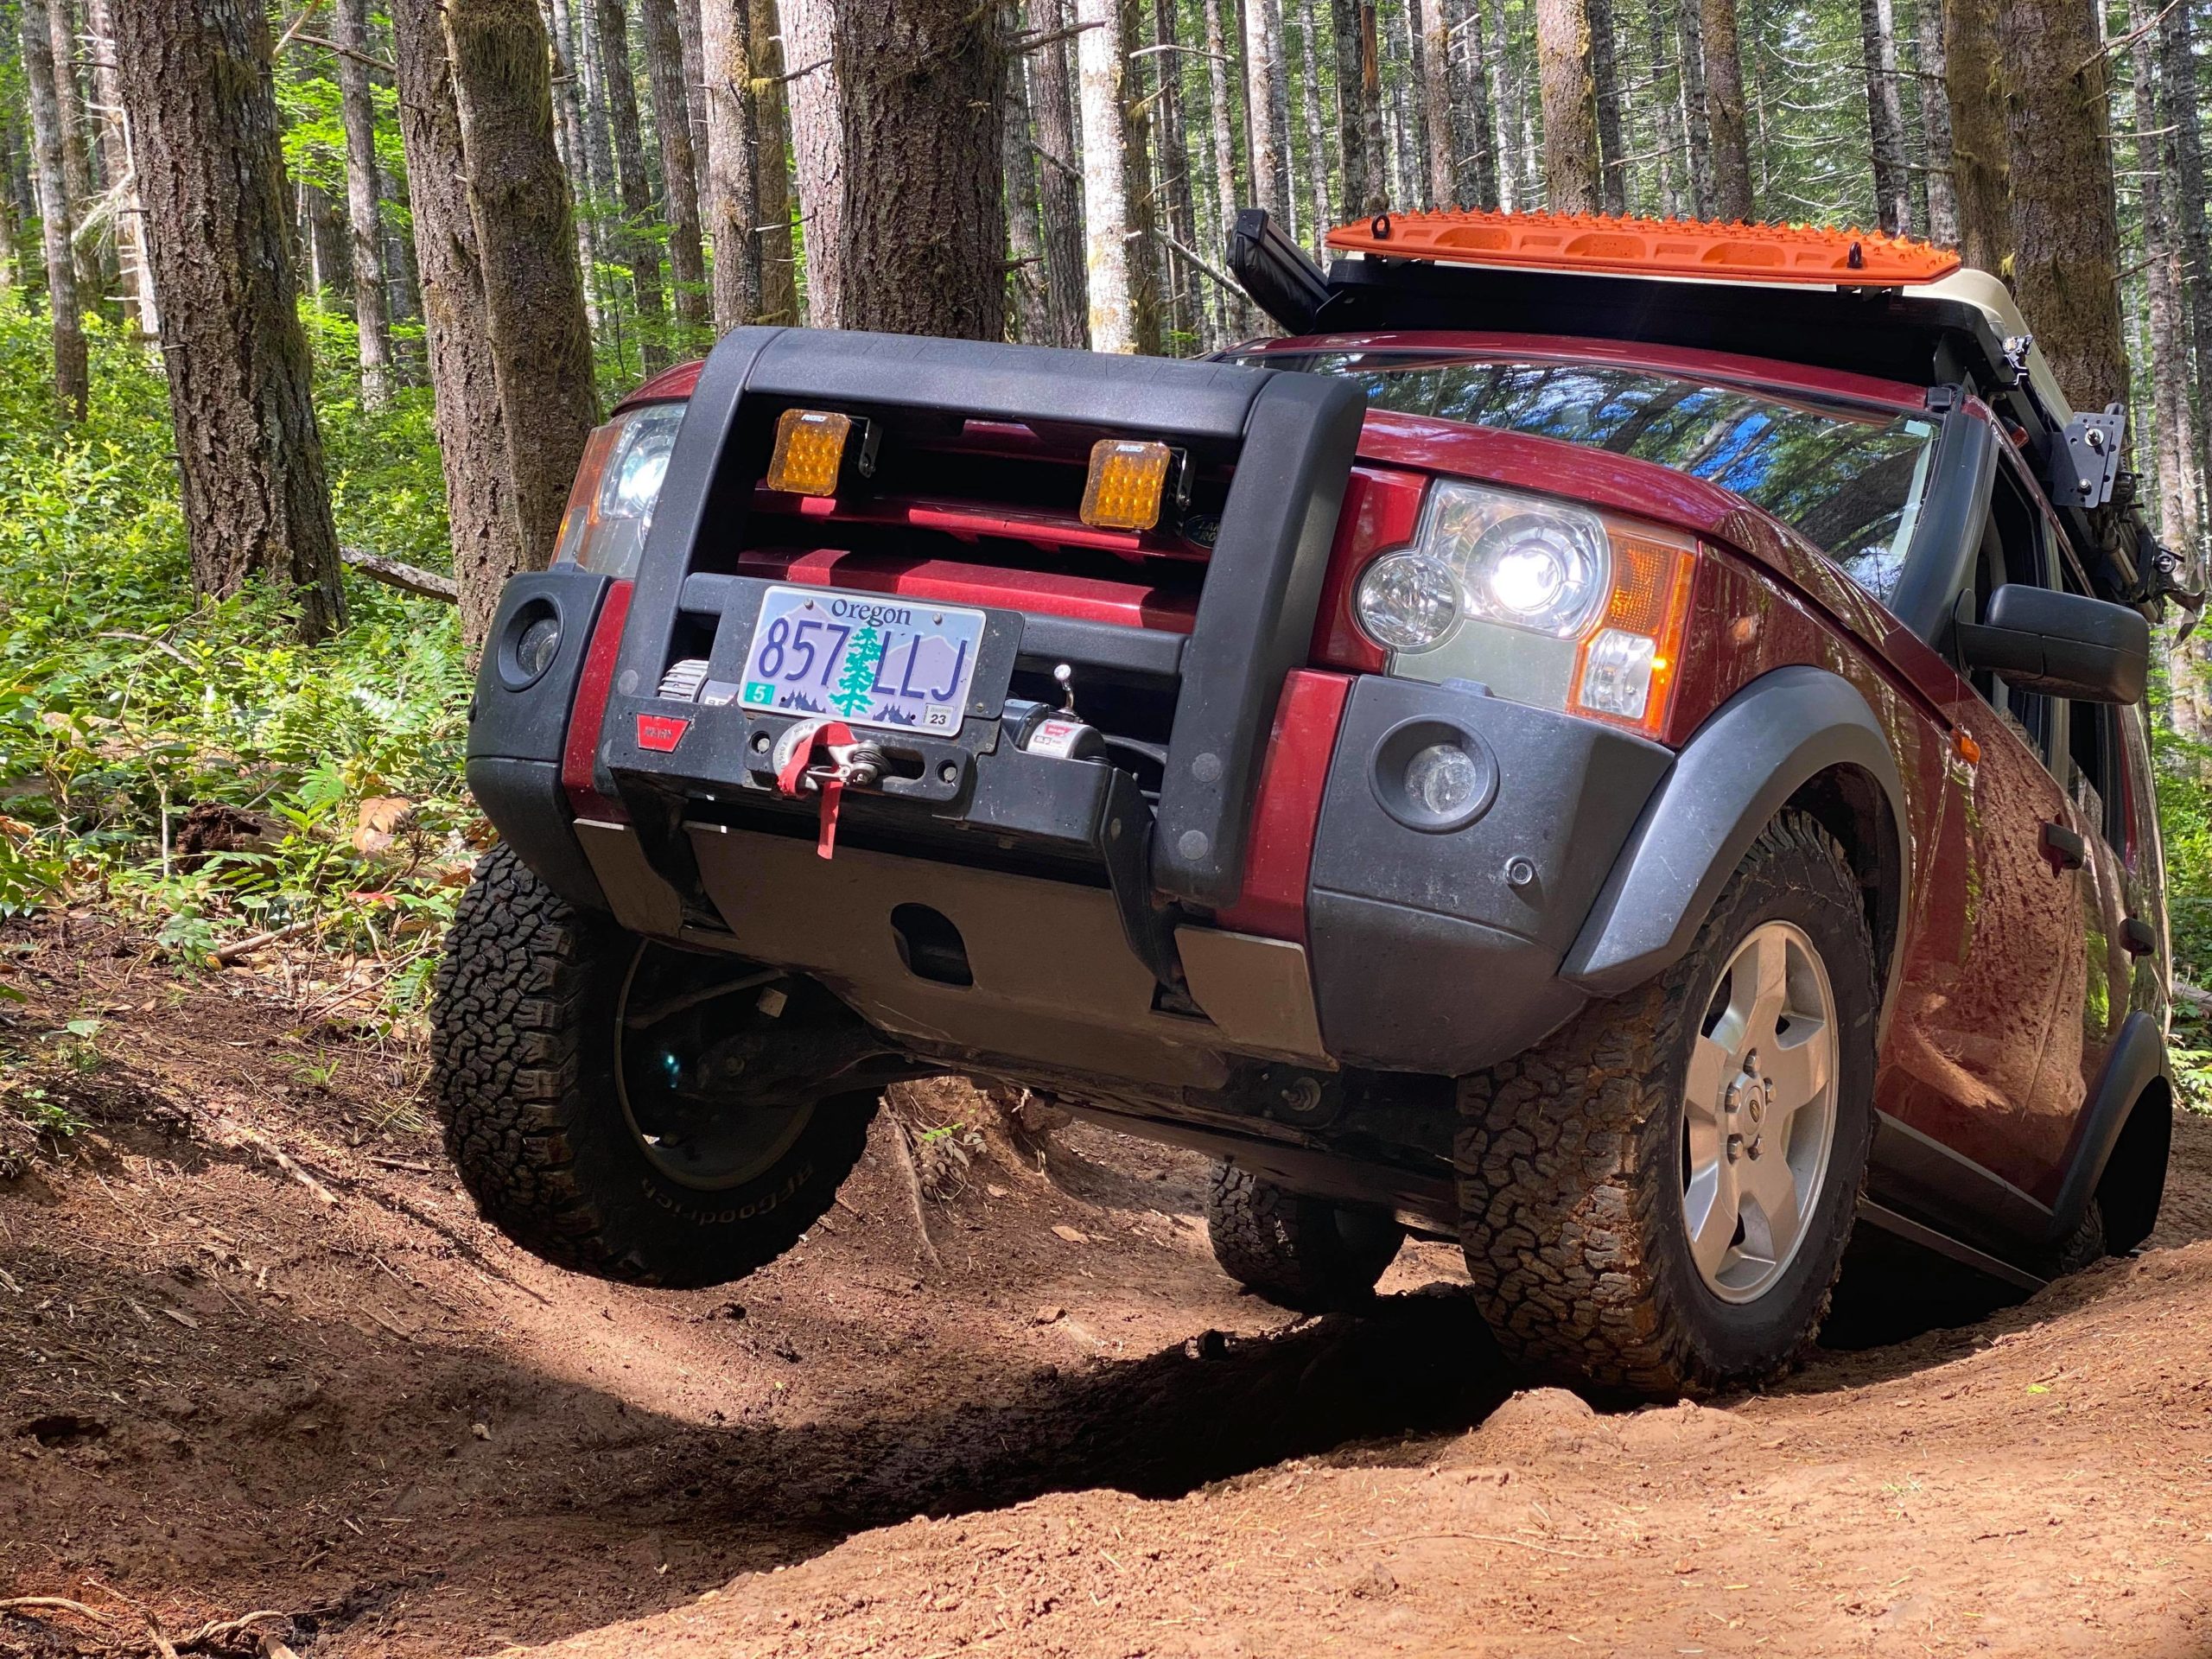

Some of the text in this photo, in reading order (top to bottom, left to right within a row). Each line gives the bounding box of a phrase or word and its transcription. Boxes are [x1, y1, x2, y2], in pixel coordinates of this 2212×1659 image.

[831, 599, 912, 626] Oregon
[759, 618, 968, 702] 857 LLJ
[752, 686, 765, 701] 5
[930, 714, 947, 725] 23
